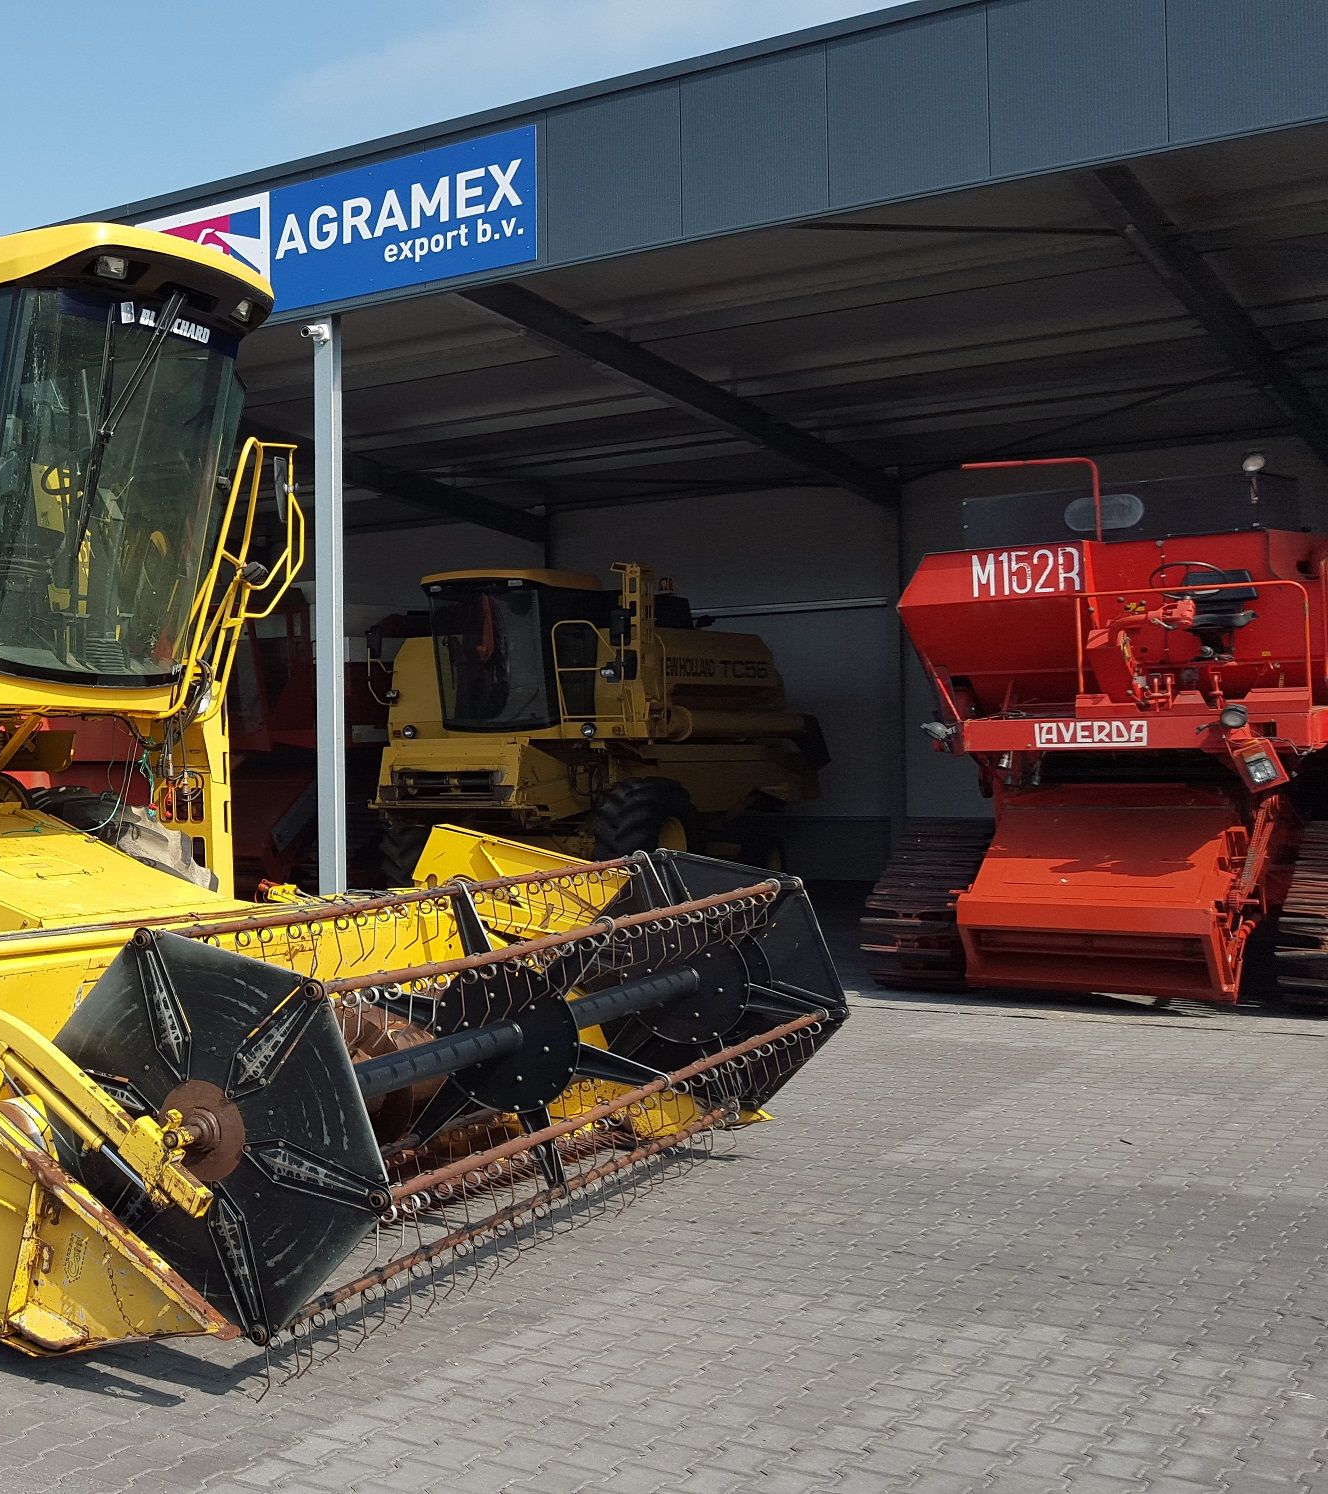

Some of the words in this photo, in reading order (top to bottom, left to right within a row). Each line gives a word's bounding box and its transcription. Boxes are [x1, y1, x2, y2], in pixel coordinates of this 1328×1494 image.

[275, 159, 523, 260] AGRAMEX
[384, 224, 469, 263] export
[477, 217, 524, 244] b.v.
[139, 308, 211, 344] BLCHARD
[971, 546, 1081, 598] M152R
[720, 660, 768, 678] TC56
[1034, 720, 1148, 748] LAVERDA
